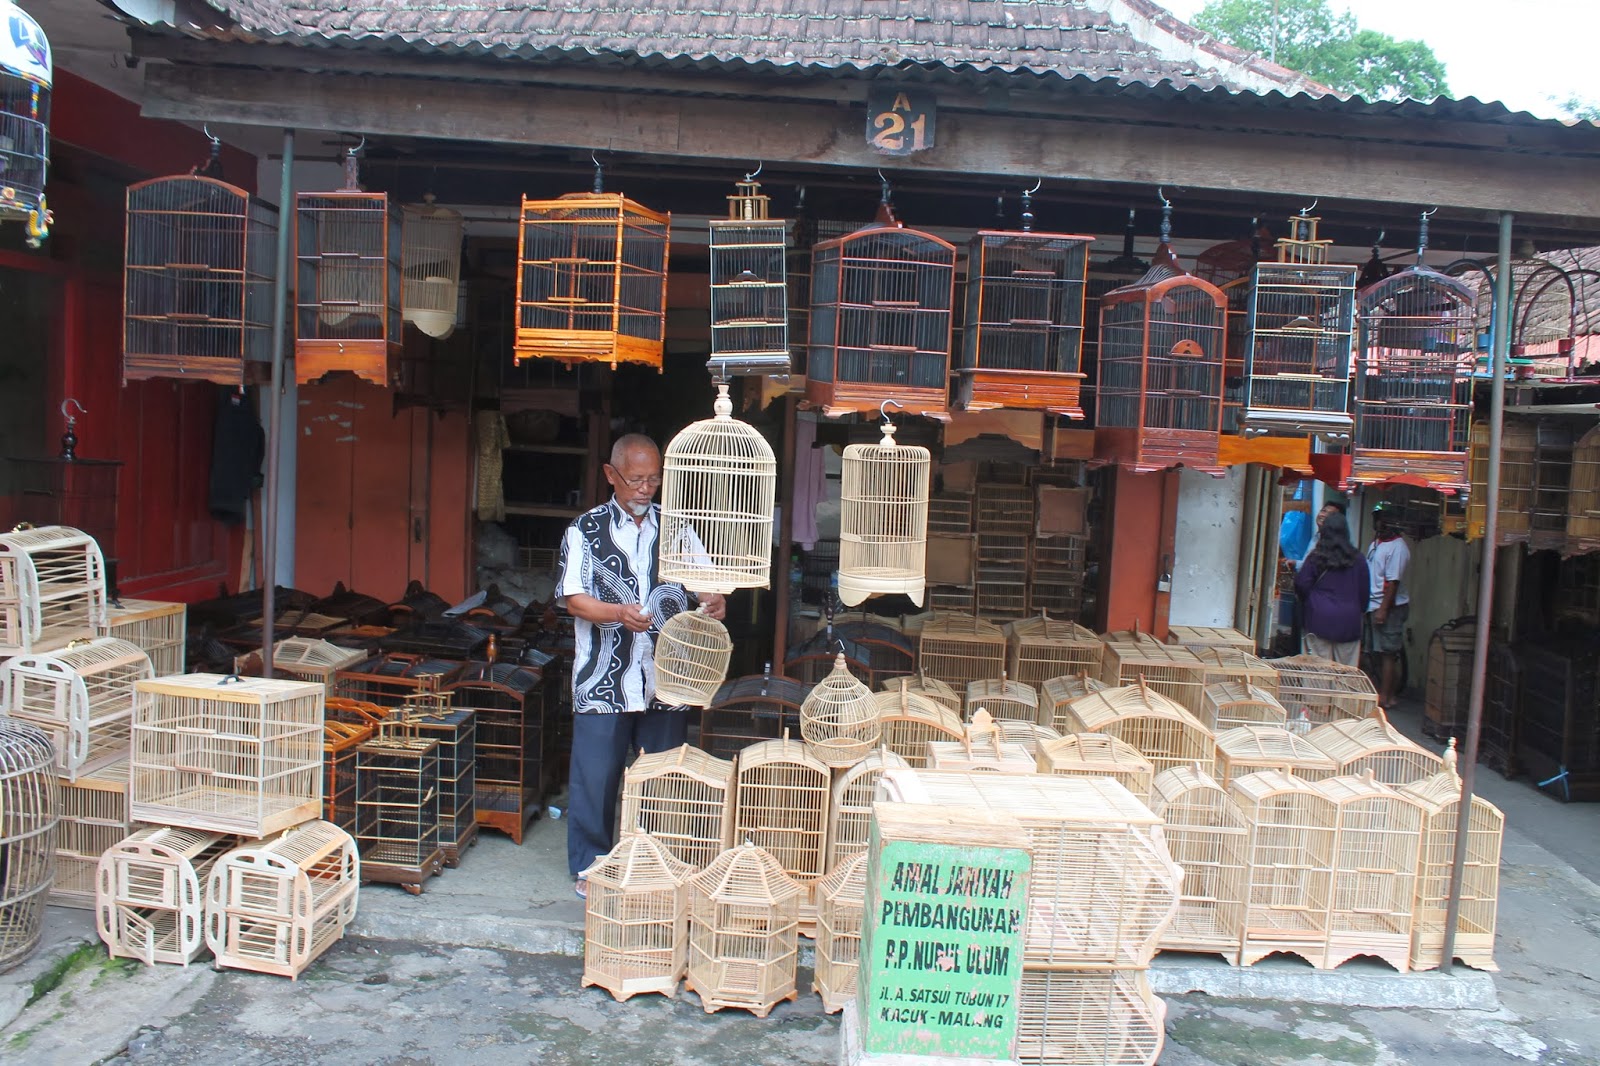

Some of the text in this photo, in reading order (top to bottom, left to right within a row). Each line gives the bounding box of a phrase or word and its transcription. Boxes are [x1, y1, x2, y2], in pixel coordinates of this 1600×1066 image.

[891, 91, 911, 111] A
[874, 112, 926, 151] 21
[891, 861, 1014, 899] AMAL JARIYAH
[881, 900, 1020, 934] PEMBANGUNAN
[966, 944, 1010, 976] ULUM
[955, 991, 995, 1008] TUBUN
[996, 994, 1010, 1008] 17
[880, 1007, 928, 1024] KACUK
[938, 1010, 1004, 1028] MALNG
